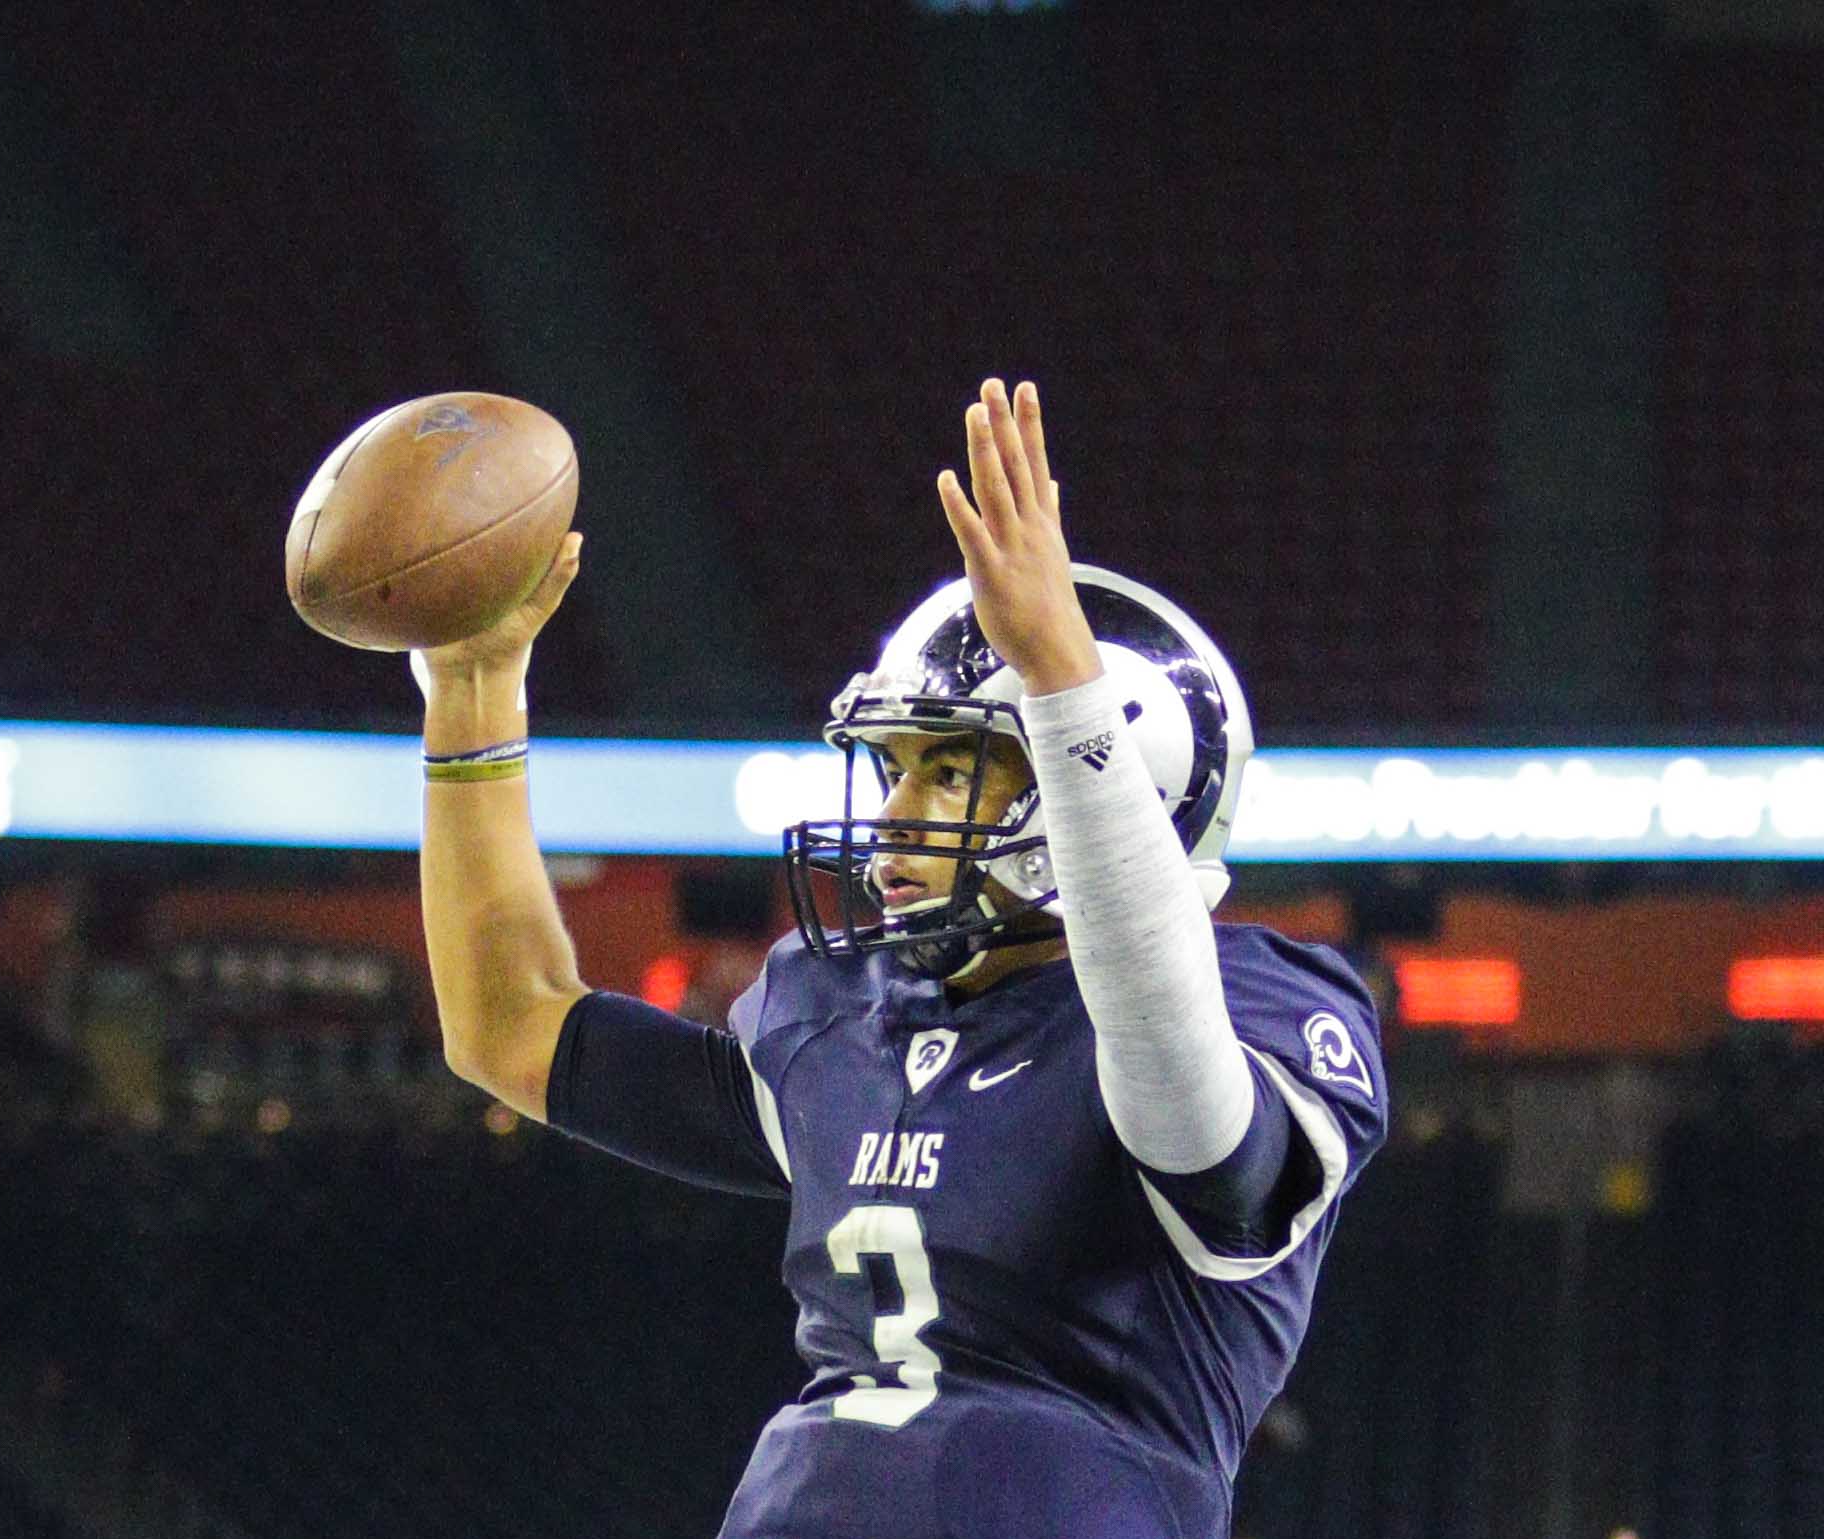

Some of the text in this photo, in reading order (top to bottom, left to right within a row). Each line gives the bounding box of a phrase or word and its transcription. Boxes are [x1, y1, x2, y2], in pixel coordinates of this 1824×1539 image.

[1067, 730, 1114, 758] adidas
[848, 1132, 945, 1189] RAMS
[826, 1204, 943, 1428] 3
